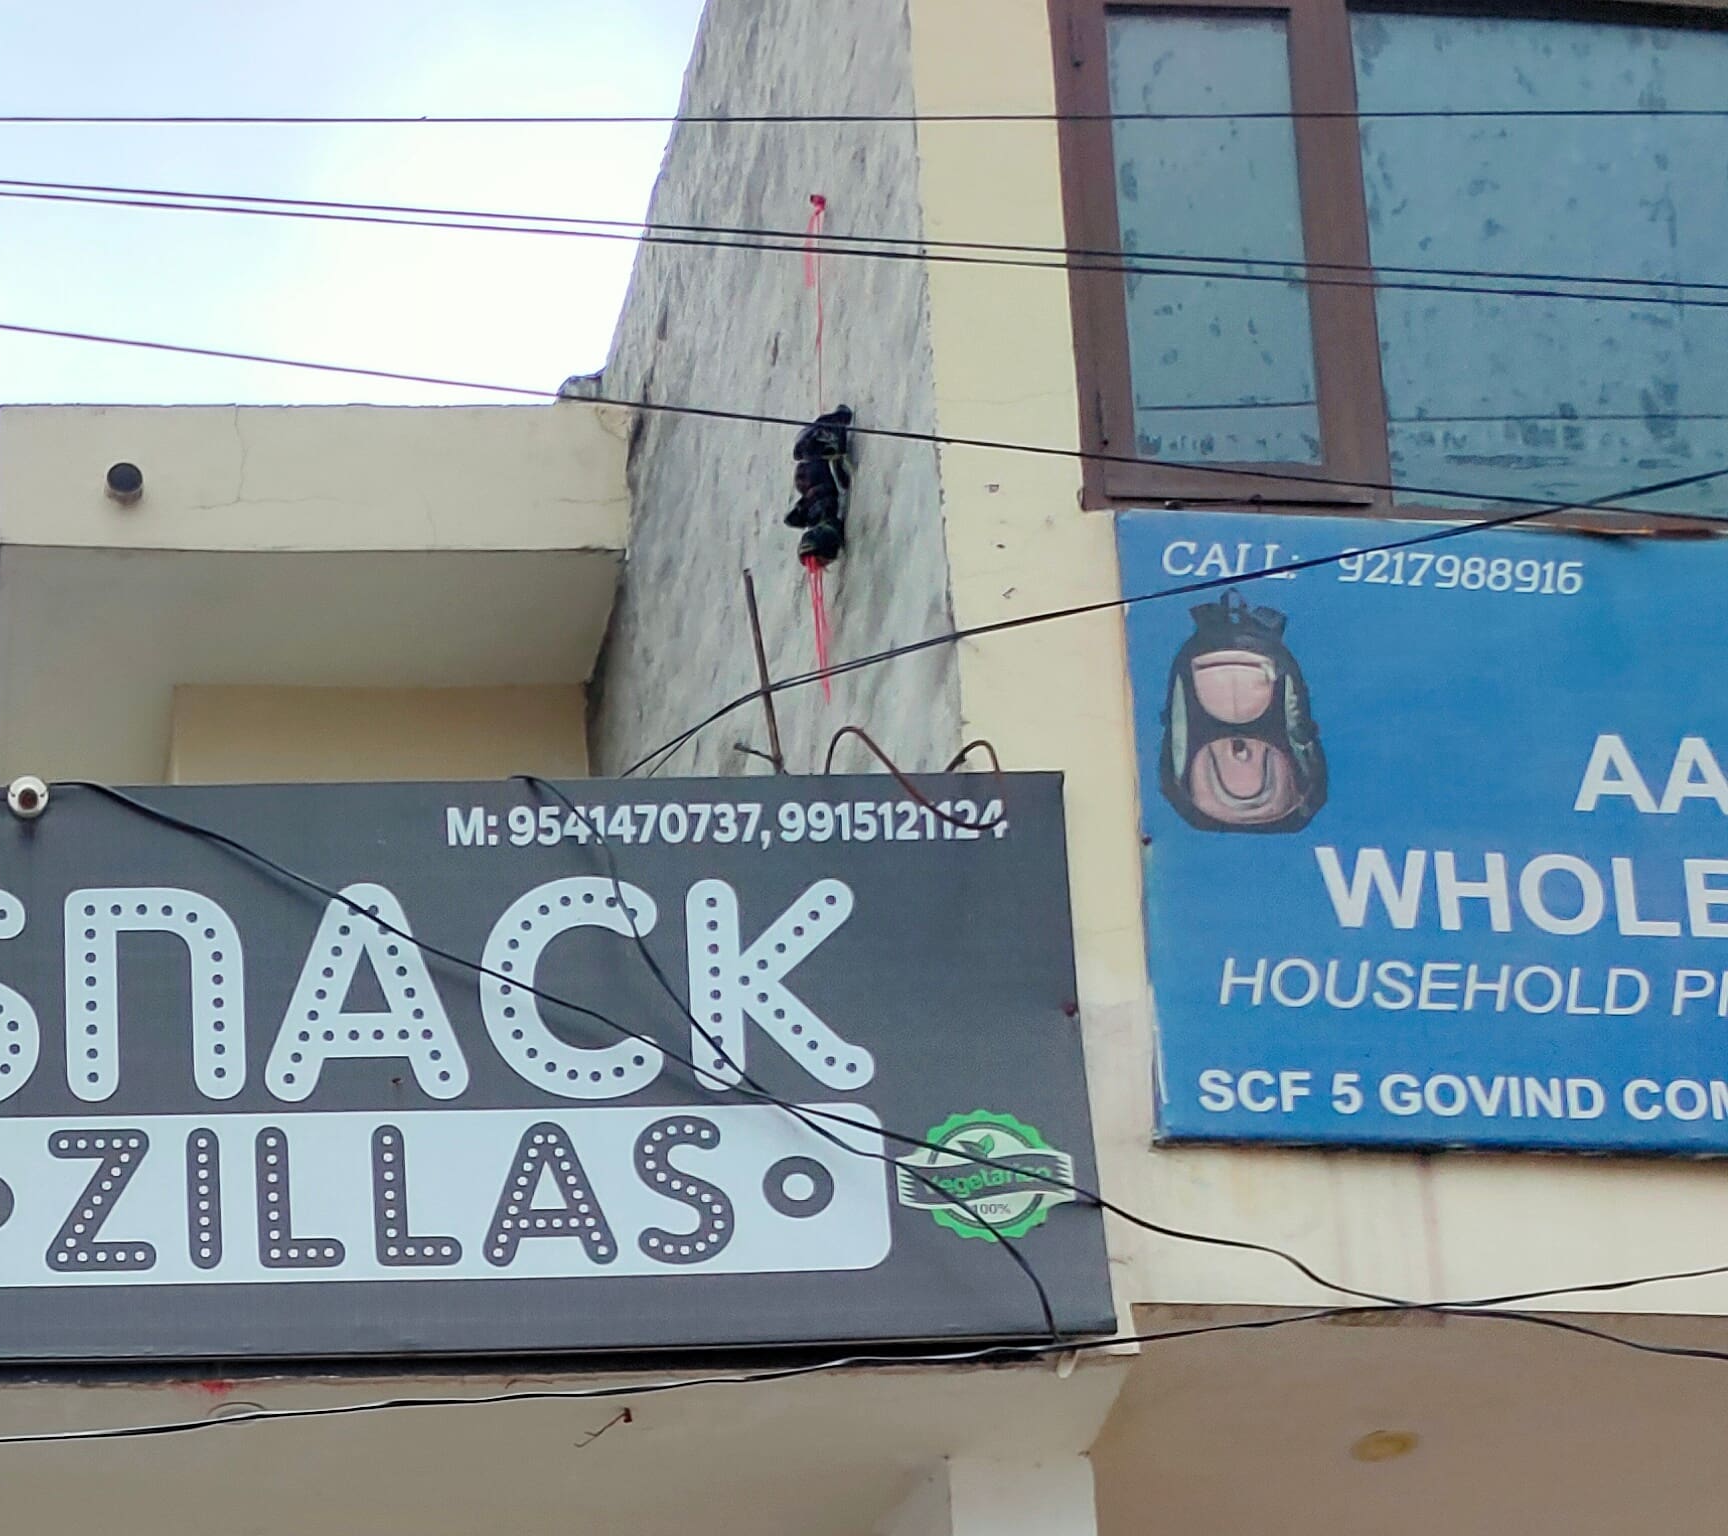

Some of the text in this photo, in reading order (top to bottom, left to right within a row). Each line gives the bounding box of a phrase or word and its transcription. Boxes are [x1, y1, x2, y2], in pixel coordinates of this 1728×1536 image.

[1162, 541, 1584, 595] CALL: 9217988916
[446, 806, 498, 846] M:
[1220, 957, 1650, 1017] HOUSEHOLD
[1198, 1068, 1312, 1114] SCF
[1331, 1072, 1363, 1115] 5
[1379, 1072, 1606, 1120] GOVIND
[45, 1116, 735, 1272] ZILLAS
